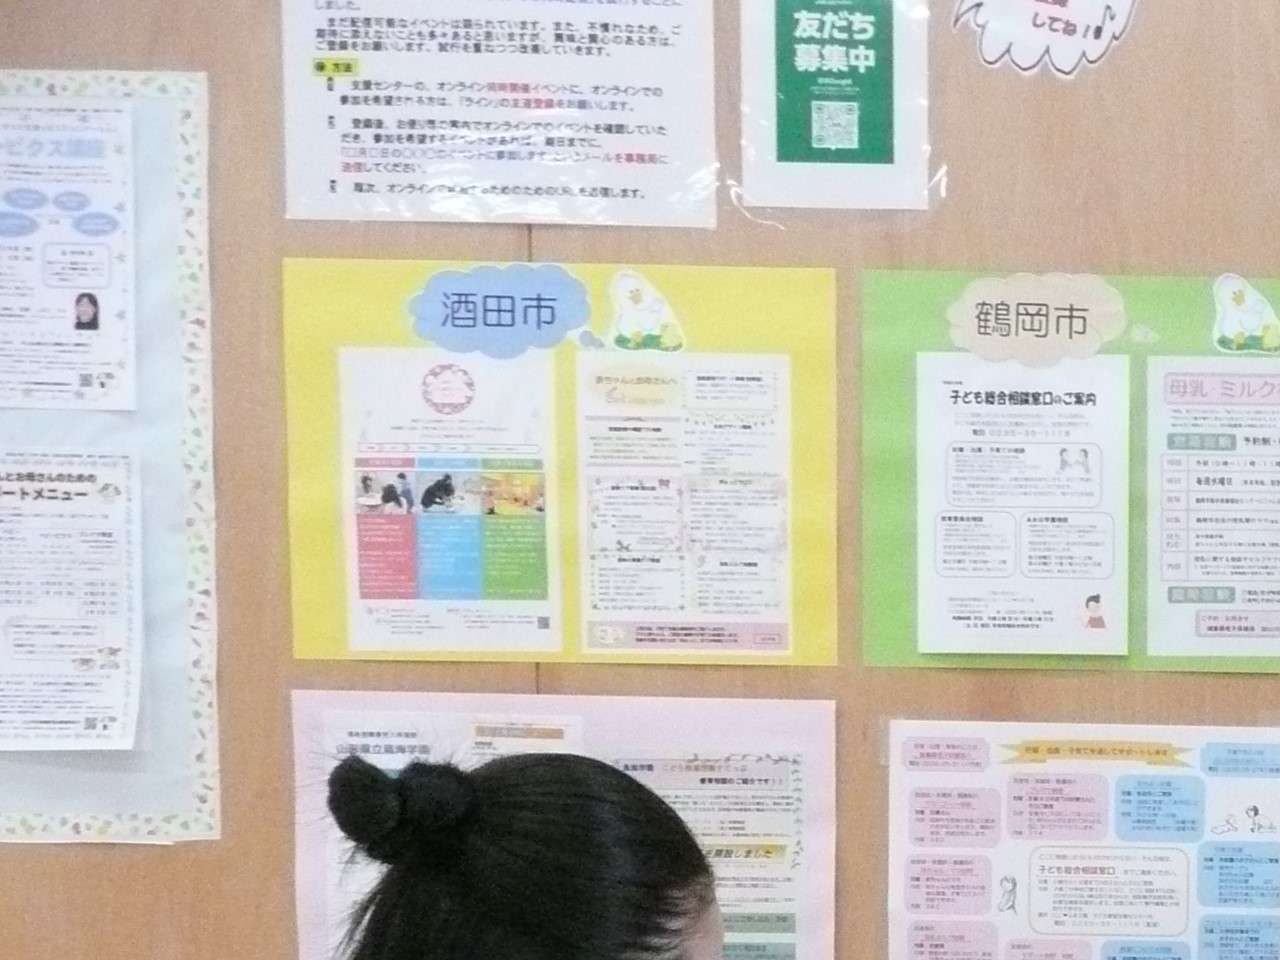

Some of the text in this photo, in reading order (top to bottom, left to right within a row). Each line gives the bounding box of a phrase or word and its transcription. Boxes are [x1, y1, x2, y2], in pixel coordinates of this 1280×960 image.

[793, 10, 876, 40] 友だち
[793, 44, 876, 74] 募集中
[441, 292, 558, 331] 酒田市
[975, 300, 1090, 340] 鶴岡市
[950, 390, 1097, 407] 子ども総合相談窓口のご案内
[0, 472, 98, 483] とお母さんのための
